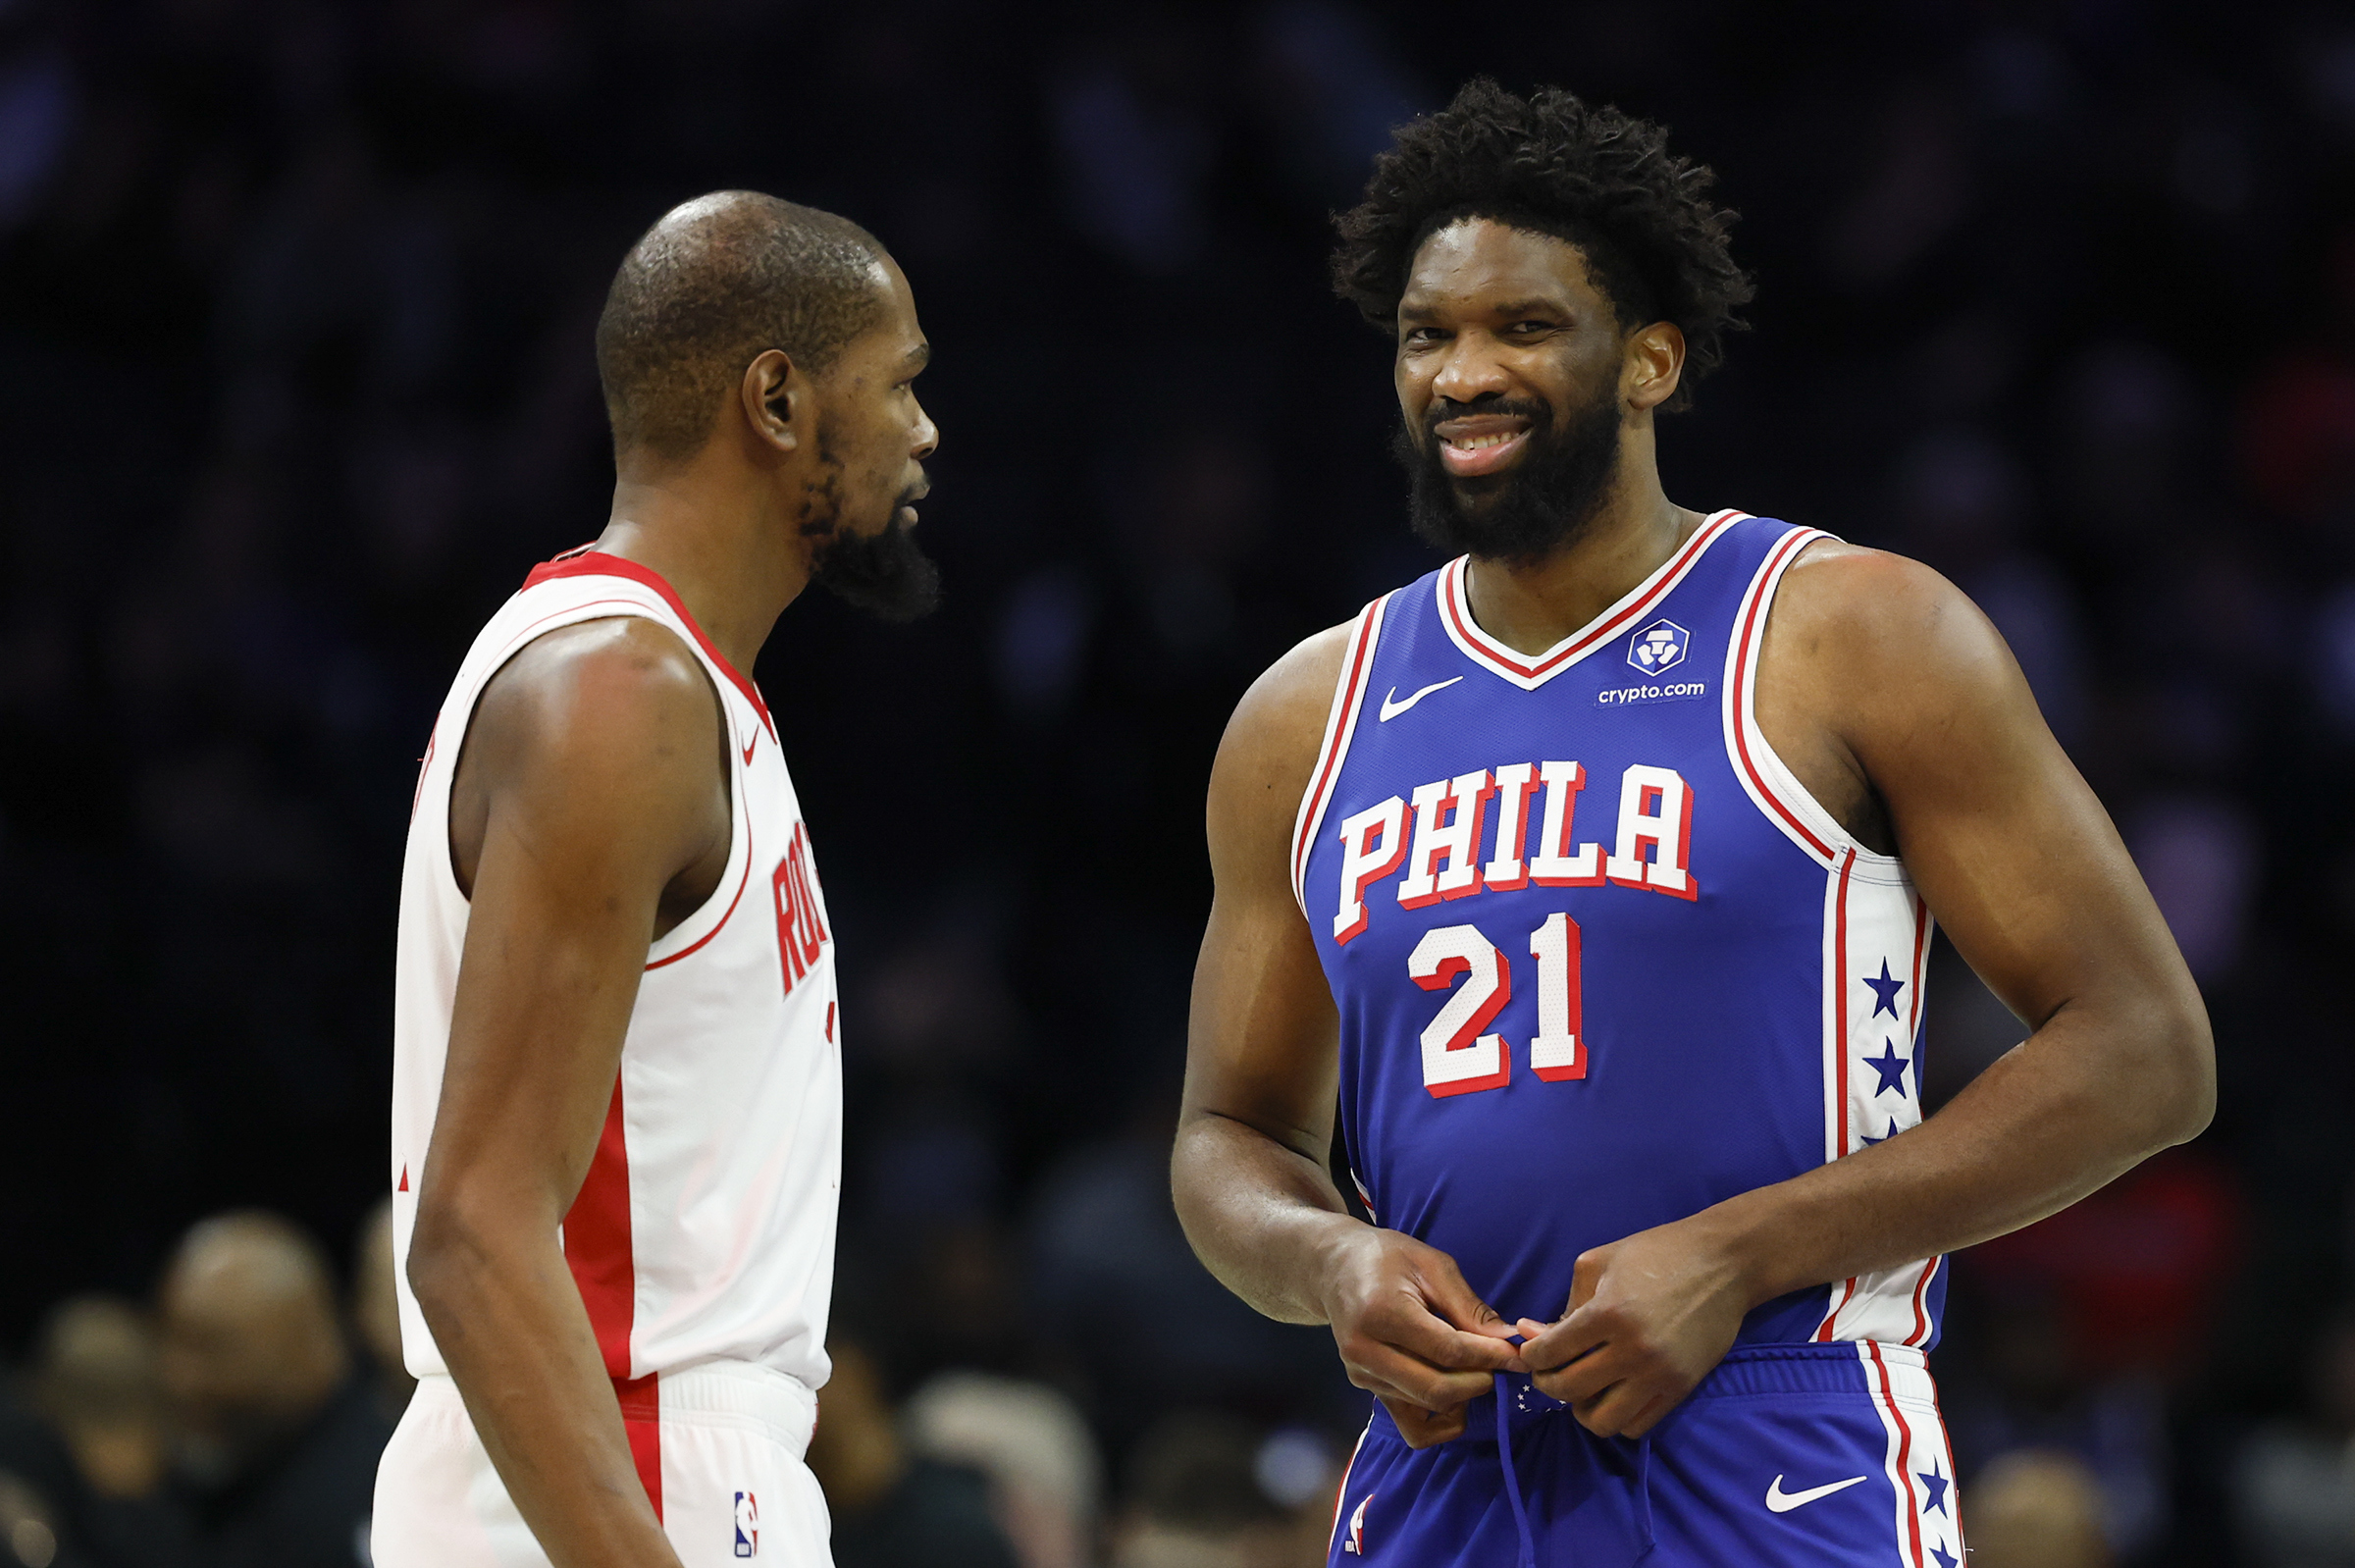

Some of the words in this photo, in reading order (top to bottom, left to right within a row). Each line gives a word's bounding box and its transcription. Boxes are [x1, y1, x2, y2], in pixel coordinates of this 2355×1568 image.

[1597, 682, 1705, 705] crypto.com
[1334, 760, 1699, 946] PHILA
[1407, 912, 1589, 1099] 21
